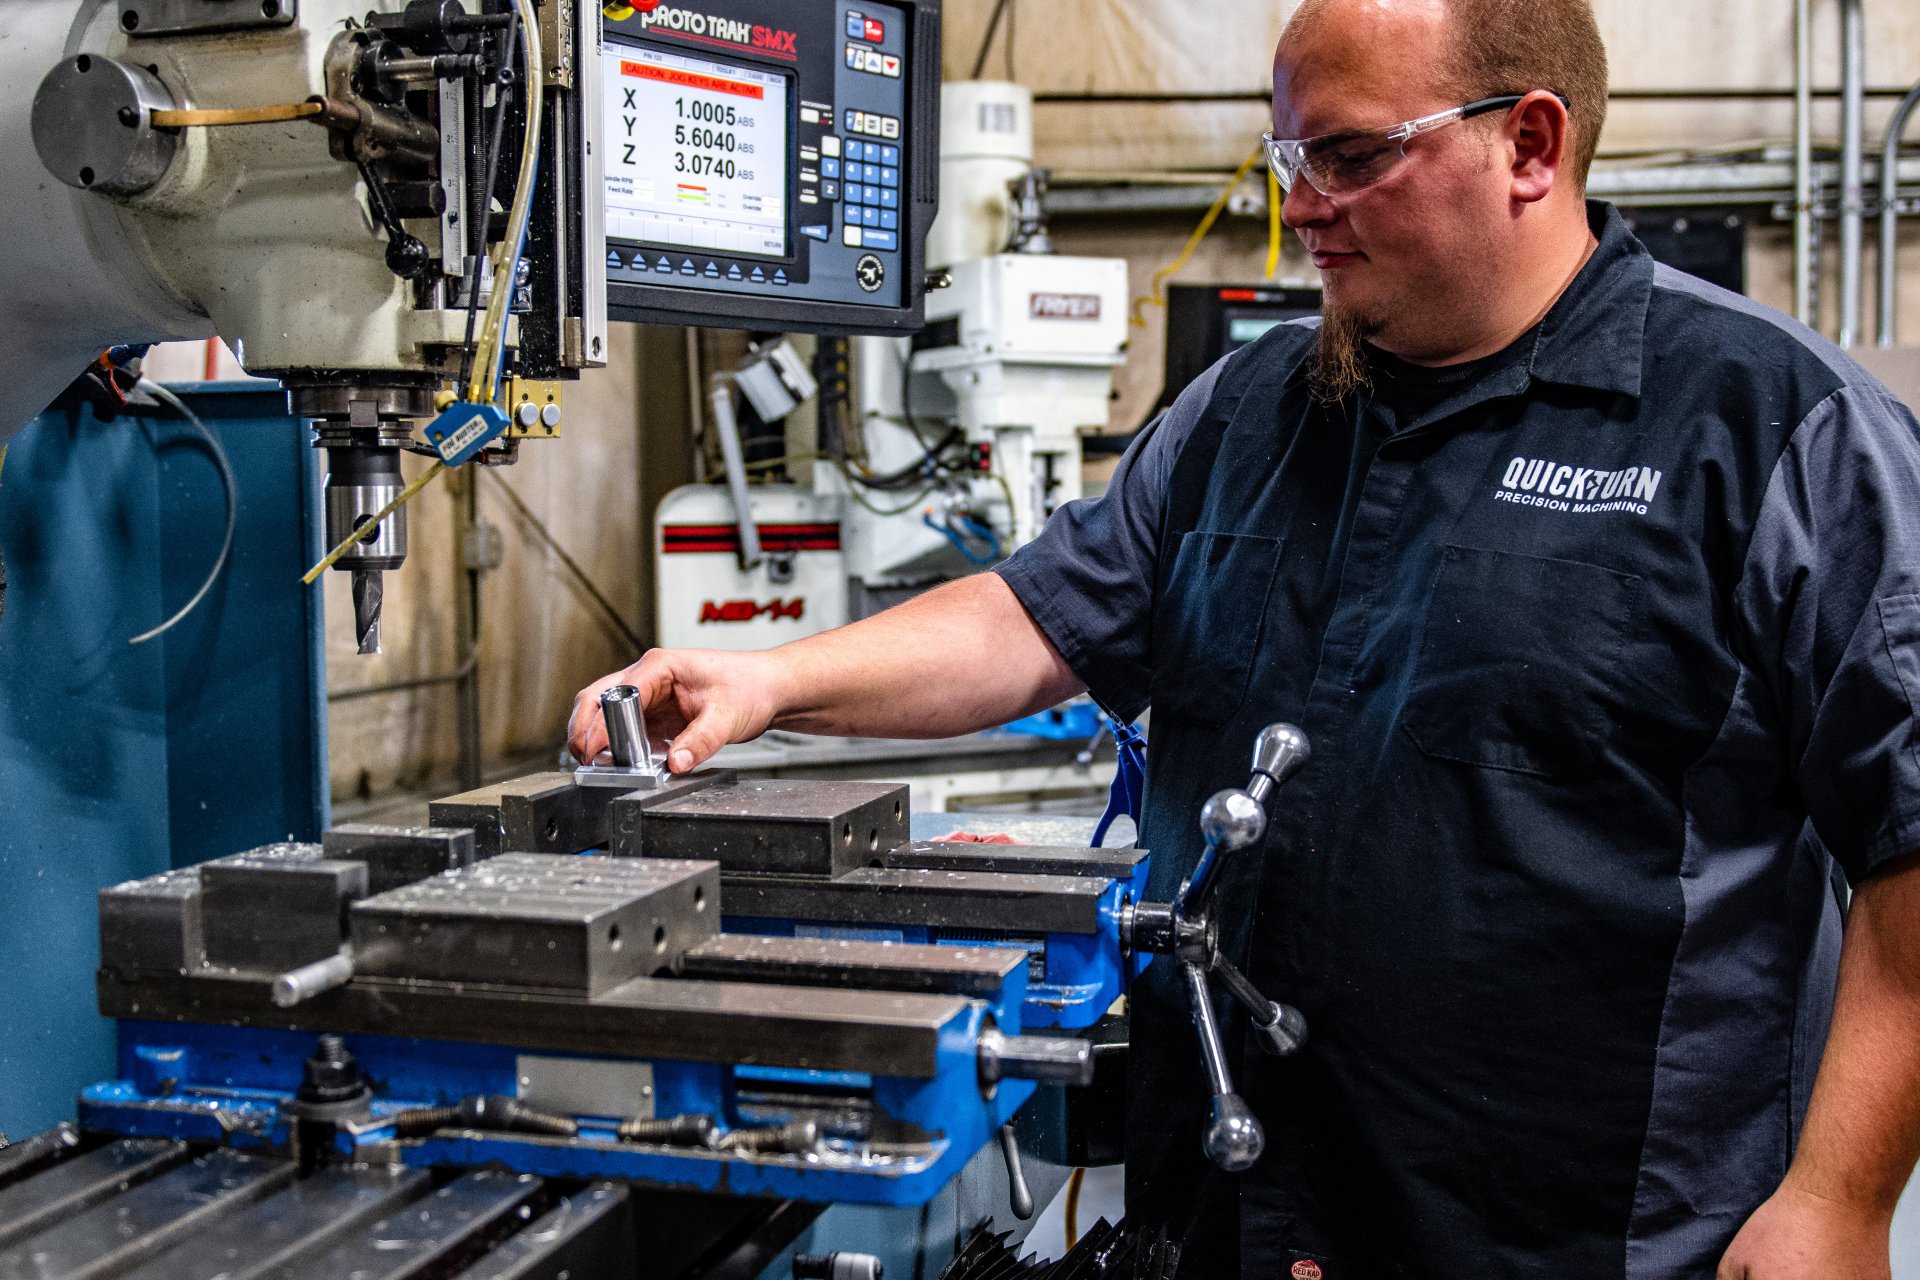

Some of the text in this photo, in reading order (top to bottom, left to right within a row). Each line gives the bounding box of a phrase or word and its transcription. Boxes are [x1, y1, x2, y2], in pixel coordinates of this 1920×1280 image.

[752, 25, 797, 54] SMX
[669, 72, 686, 81] JOG
[688, 75, 709, 86] KEYS
[712, 80, 728, 89] ARE
[731, 83, 757, 95] ACTIVE
[623, 87, 755, 128] X 1.0005 ABS
[623, 115, 755, 154] Y 5.6040 ABS
[848, 142, 855, 151] 7
[622, 143, 755, 181] Z 3.0740 ABS
[827, 163, 834, 172] Y
[848, 164, 855, 173] 4
[865, 166, 873, 176] 5
[622, 187, 633, 195] Rate
[826, 185, 834, 194] Z
[848, 186, 853, 194] 1
[864, 188, 872, 197] 2
[742, 193, 762, 202] Override
[742, 203, 762, 212] Override
[864, 209, 872, 218] 0
[1494, 490, 1648, 515] PRECISION MACHINING
[1293, 1266, 1320, 1279] RED KAP
